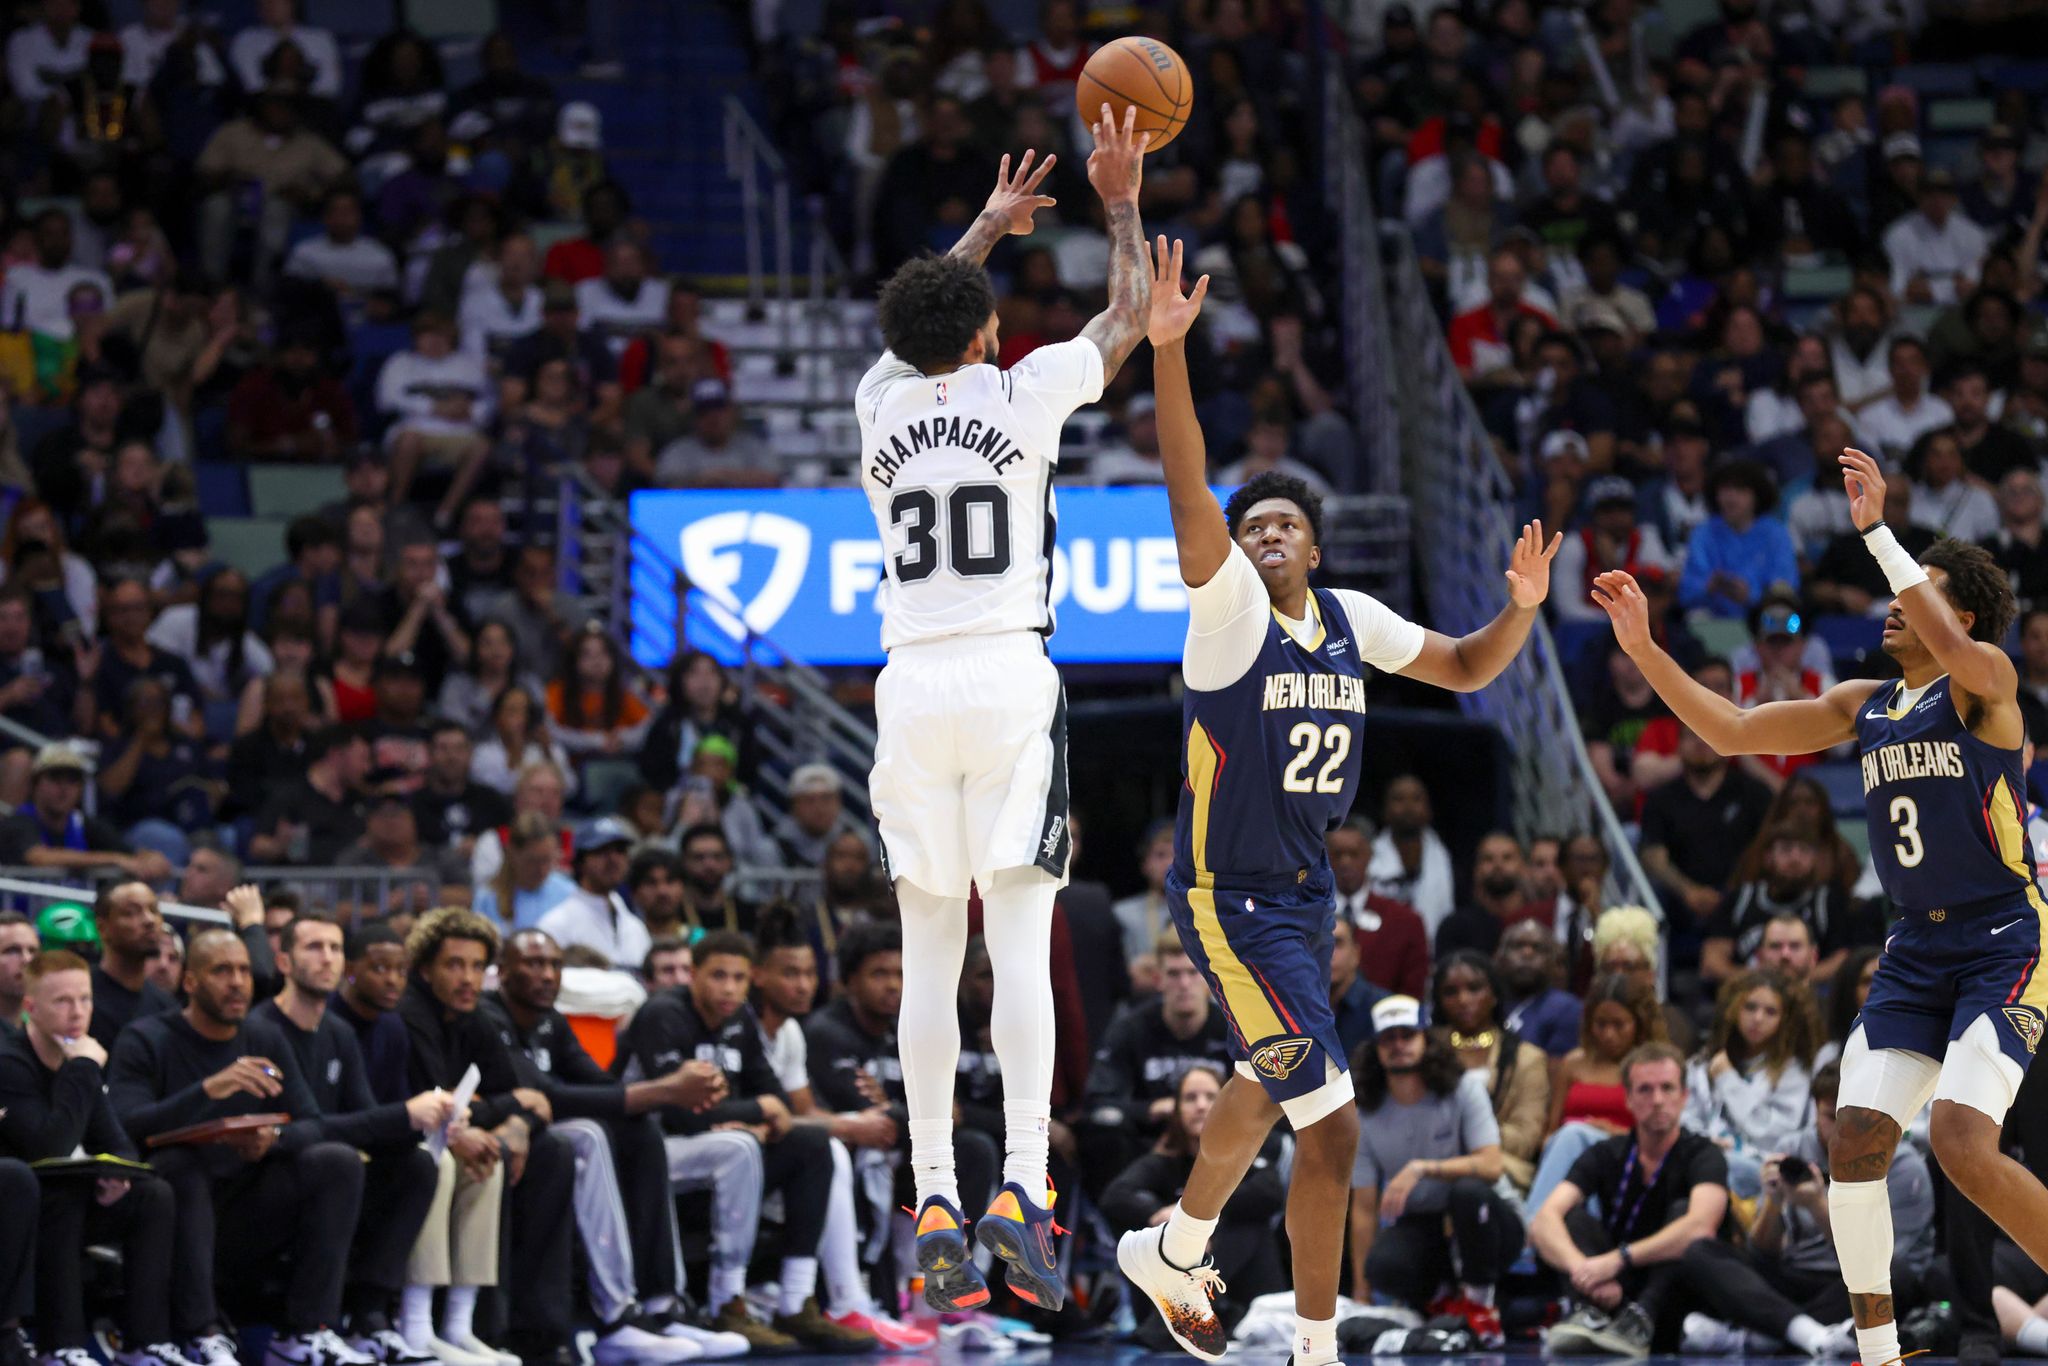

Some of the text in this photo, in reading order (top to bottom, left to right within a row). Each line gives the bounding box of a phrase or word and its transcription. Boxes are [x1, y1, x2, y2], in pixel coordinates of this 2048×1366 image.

[870, 416, 1024, 488] CHAMPAGNIE
[889, 481, 1013, 587] 30
[1262, 673, 1366, 714] NEW ORLEAN
[1283, 721, 1351, 793] 22
[1879, 741, 1964, 783] ORLEANS
[1889, 796, 1924, 868] 3
